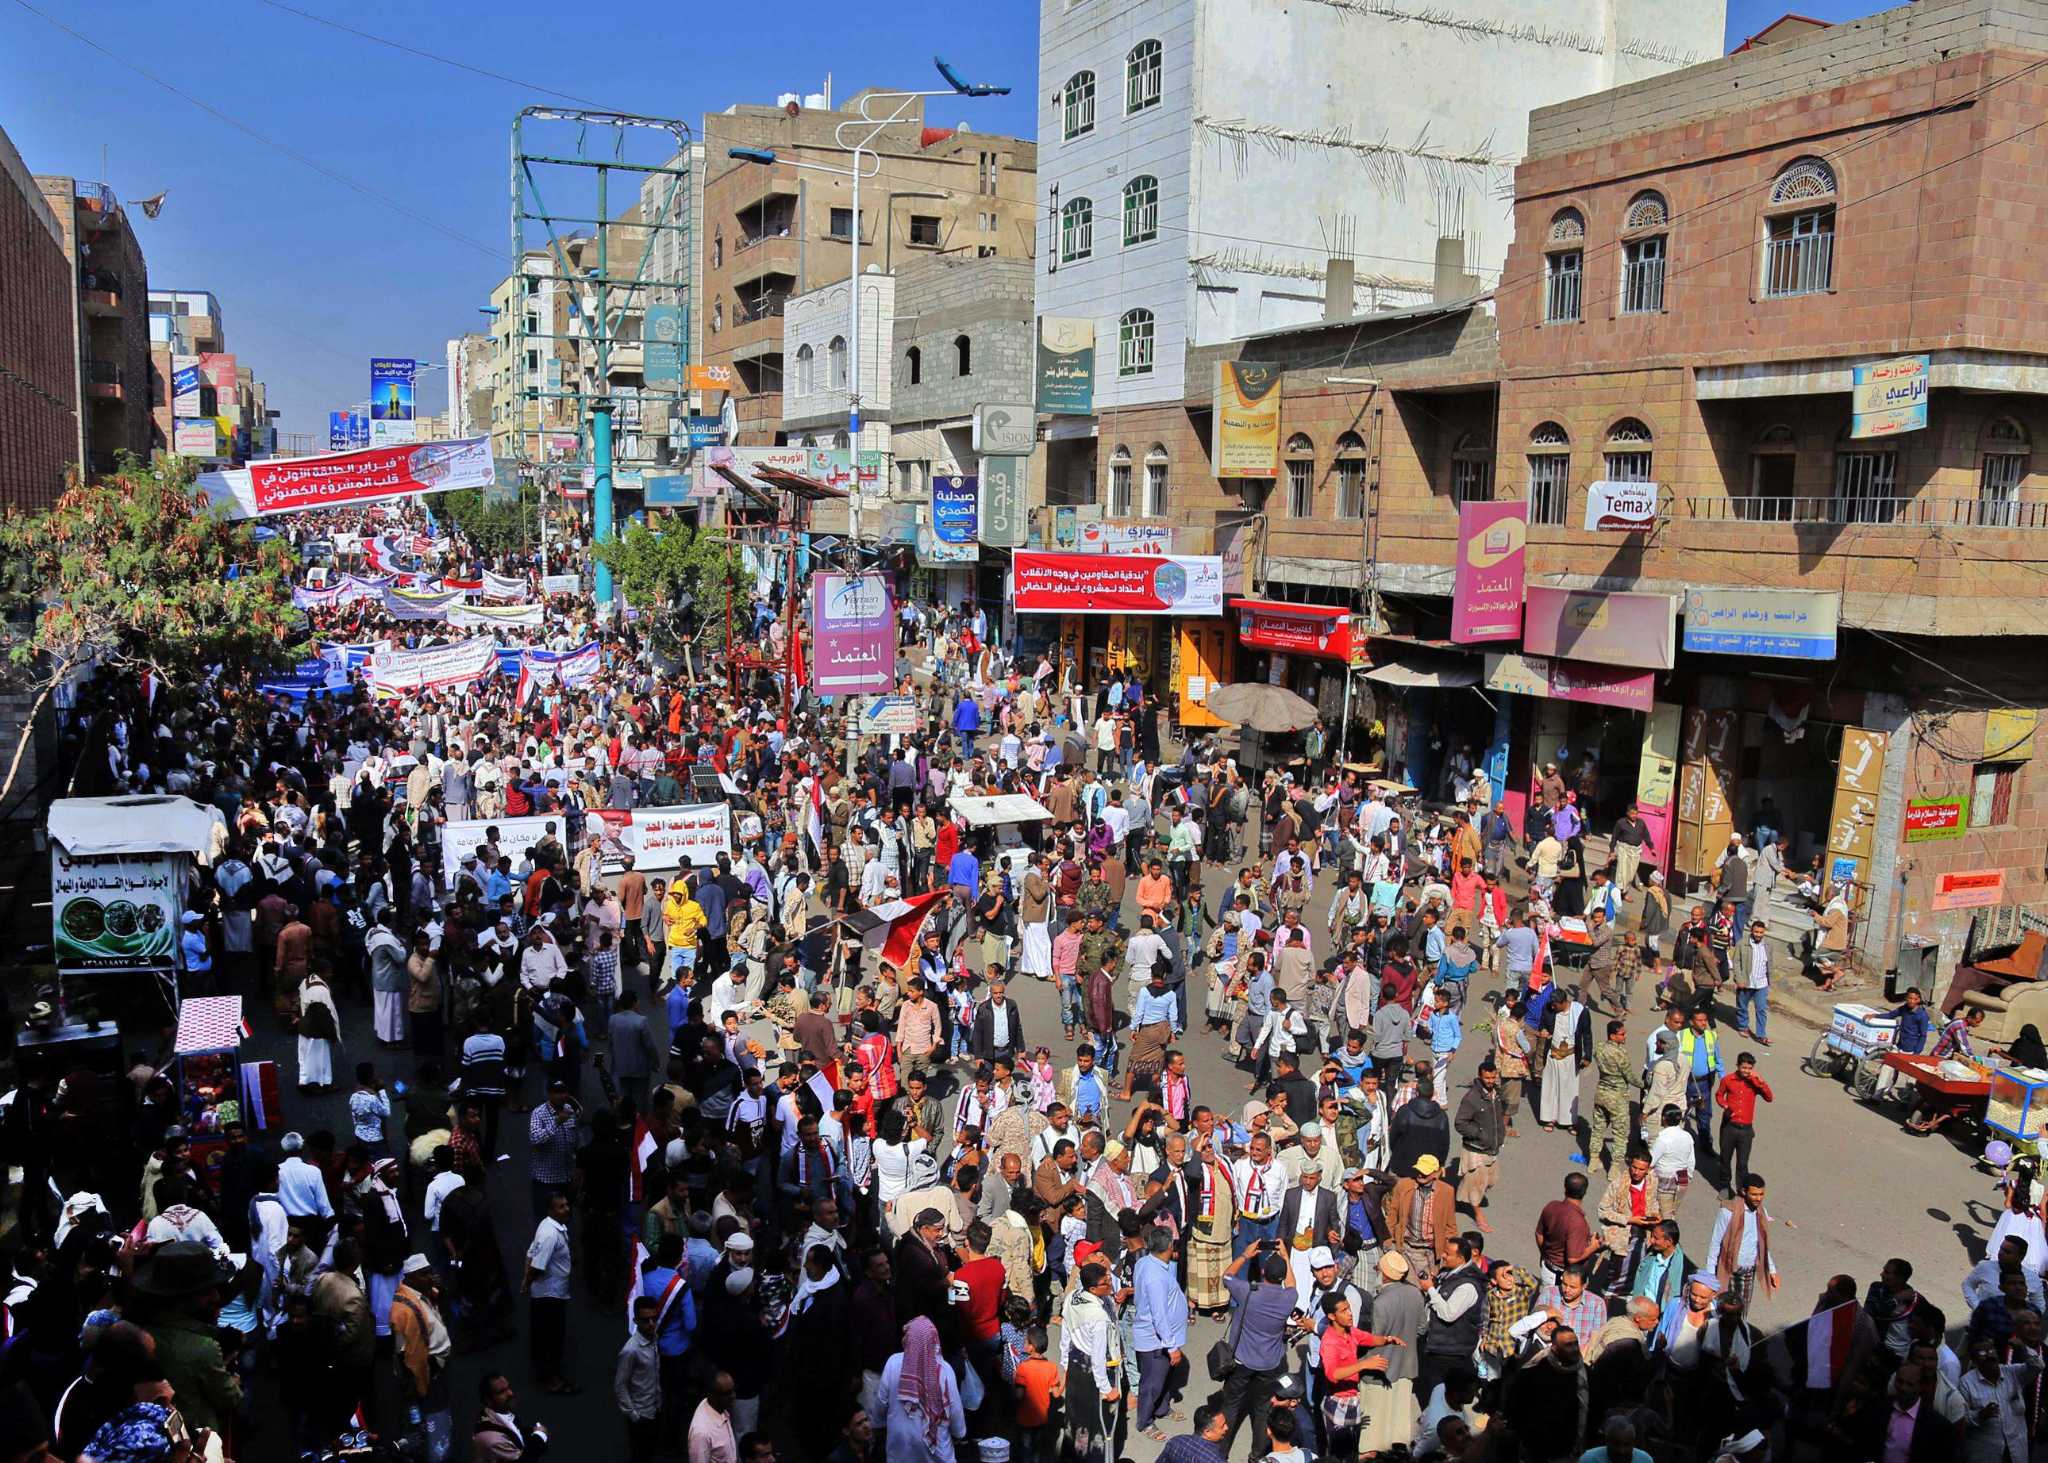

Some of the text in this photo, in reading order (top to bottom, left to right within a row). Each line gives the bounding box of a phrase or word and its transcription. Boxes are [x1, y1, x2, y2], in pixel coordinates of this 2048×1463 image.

[312, 463, 354, 478] الطلقة
[261, 471, 278, 488] في
[320, 476, 372, 494] المشروع
[373, 473, 399, 486] قلب
[937, 489, 975, 501] صيدلية
[936, 504, 975, 517] الحمدي
[1605, 495, 1653, 515] Temax
[1067, 569, 1079, 581] في
[1080, 569, 1120, 580] المقاومين
[1053, 581, 1080, 593] فبراير
[831, 642, 881, 664] المعتمد
